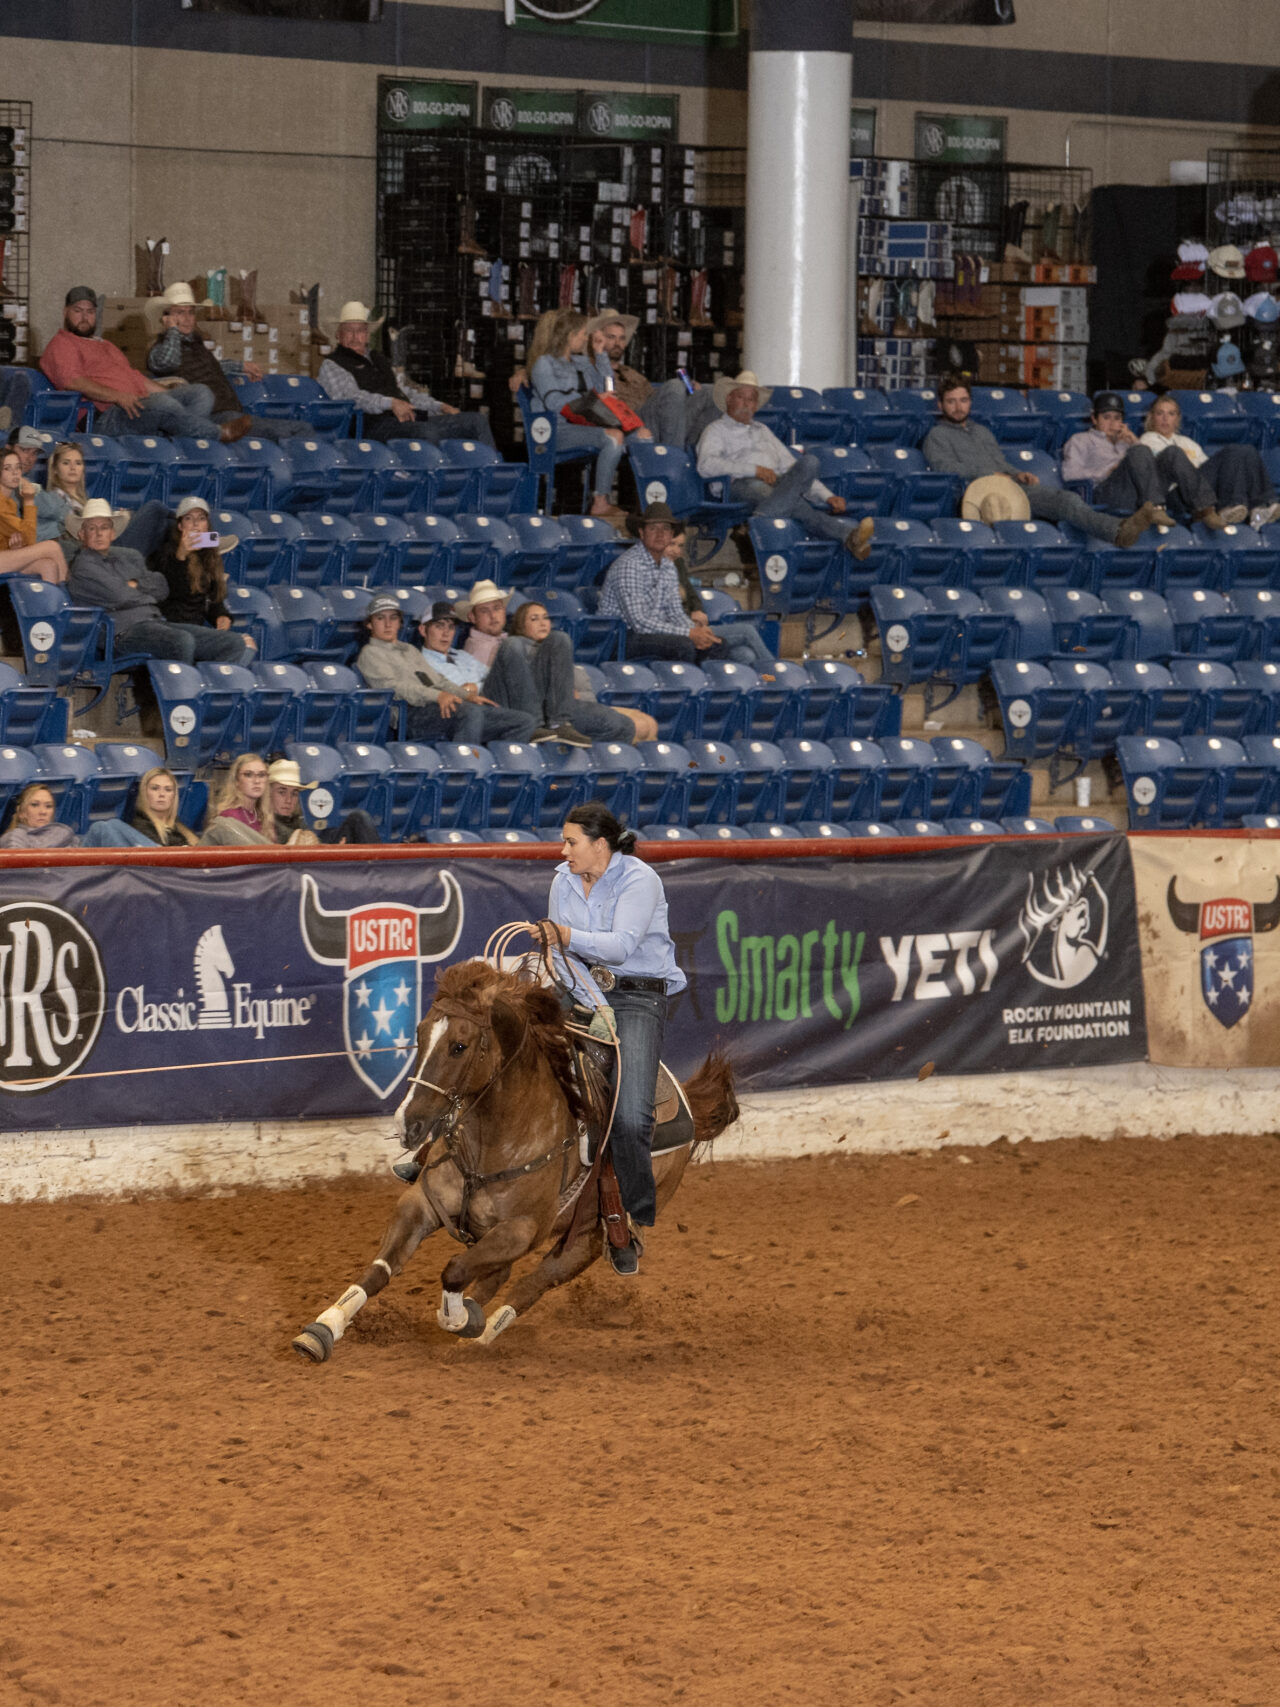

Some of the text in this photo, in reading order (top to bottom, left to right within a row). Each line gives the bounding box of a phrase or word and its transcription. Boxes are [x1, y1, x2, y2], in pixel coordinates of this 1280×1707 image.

[1205, 905, 1250, 931] USTRC
[353, 917, 413, 953] USTRC
[715, 909, 999, 1030] Smarty YETI
[115, 983, 312, 1040] Classic Equine
[1002, 1000, 1132, 1025] ROCKY MOUNTAIN
[1007, 1020, 1131, 1045] ELK FOUNDATION
